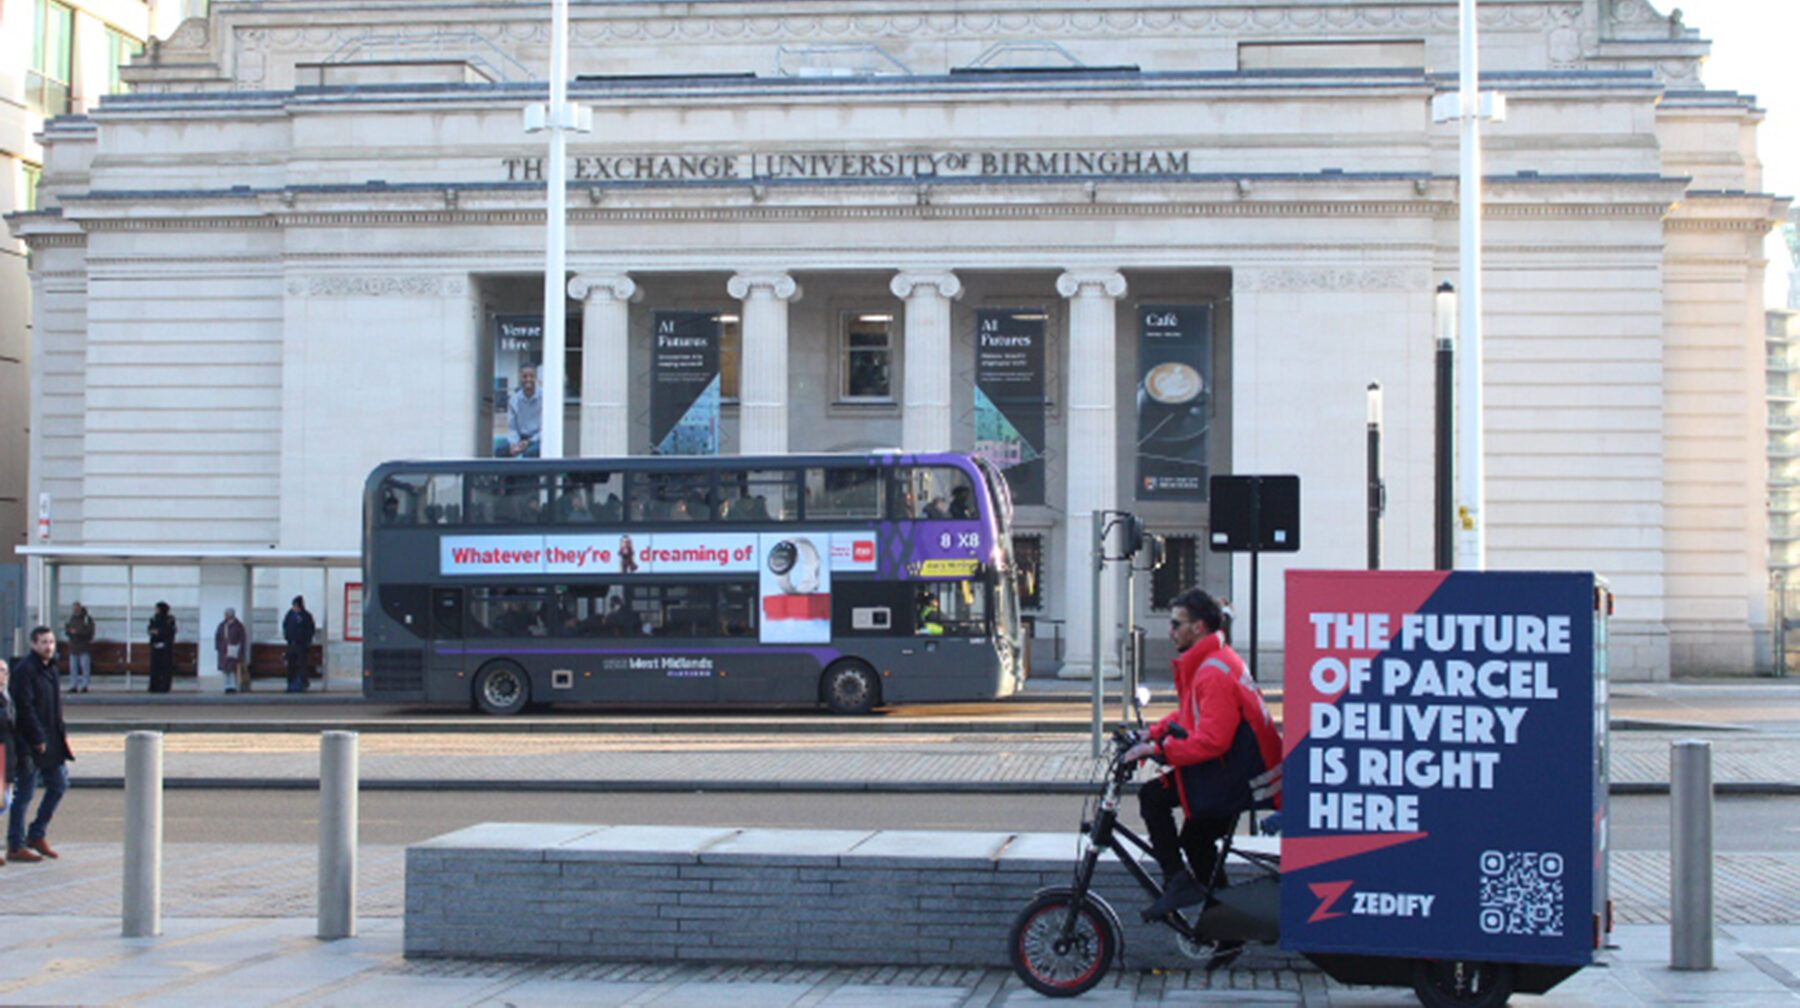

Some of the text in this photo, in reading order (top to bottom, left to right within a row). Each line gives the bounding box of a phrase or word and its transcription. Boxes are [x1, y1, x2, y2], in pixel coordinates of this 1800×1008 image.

[502, 156, 545, 181] TH
[575, 155, 739, 179] EXCHANGE
[766, 153, 946, 177] UNIVERSITY
[981, 151, 1190, 175] BIRMINGHAM
[659, 320, 674, 333] AI
[982, 319, 998, 331] AI
[1146, 312, 1178, 327] Café
[502, 338, 530, 351] Hire
[659, 335, 708, 347] Futures
[981, 333, 1031, 347] Futures
[940, 532, 979, 549] 8 X8
[452, 544, 753, 567] Whatever they're dreaming of
[1309, 612, 1571, 654] THE FUTURE
[629, 657, 659, 669] West
[661, 657, 713, 669] Midlands
[1310, 657, 1559, 699] OF PARCEL
[1310, 702, 1527, 743] DELIVERY
[1309, 747, 1499, 789] IS RIGHT
[1309, 792, 1419, 832] HERE
[1352, 891, 1436, 917] ZEDIFY
